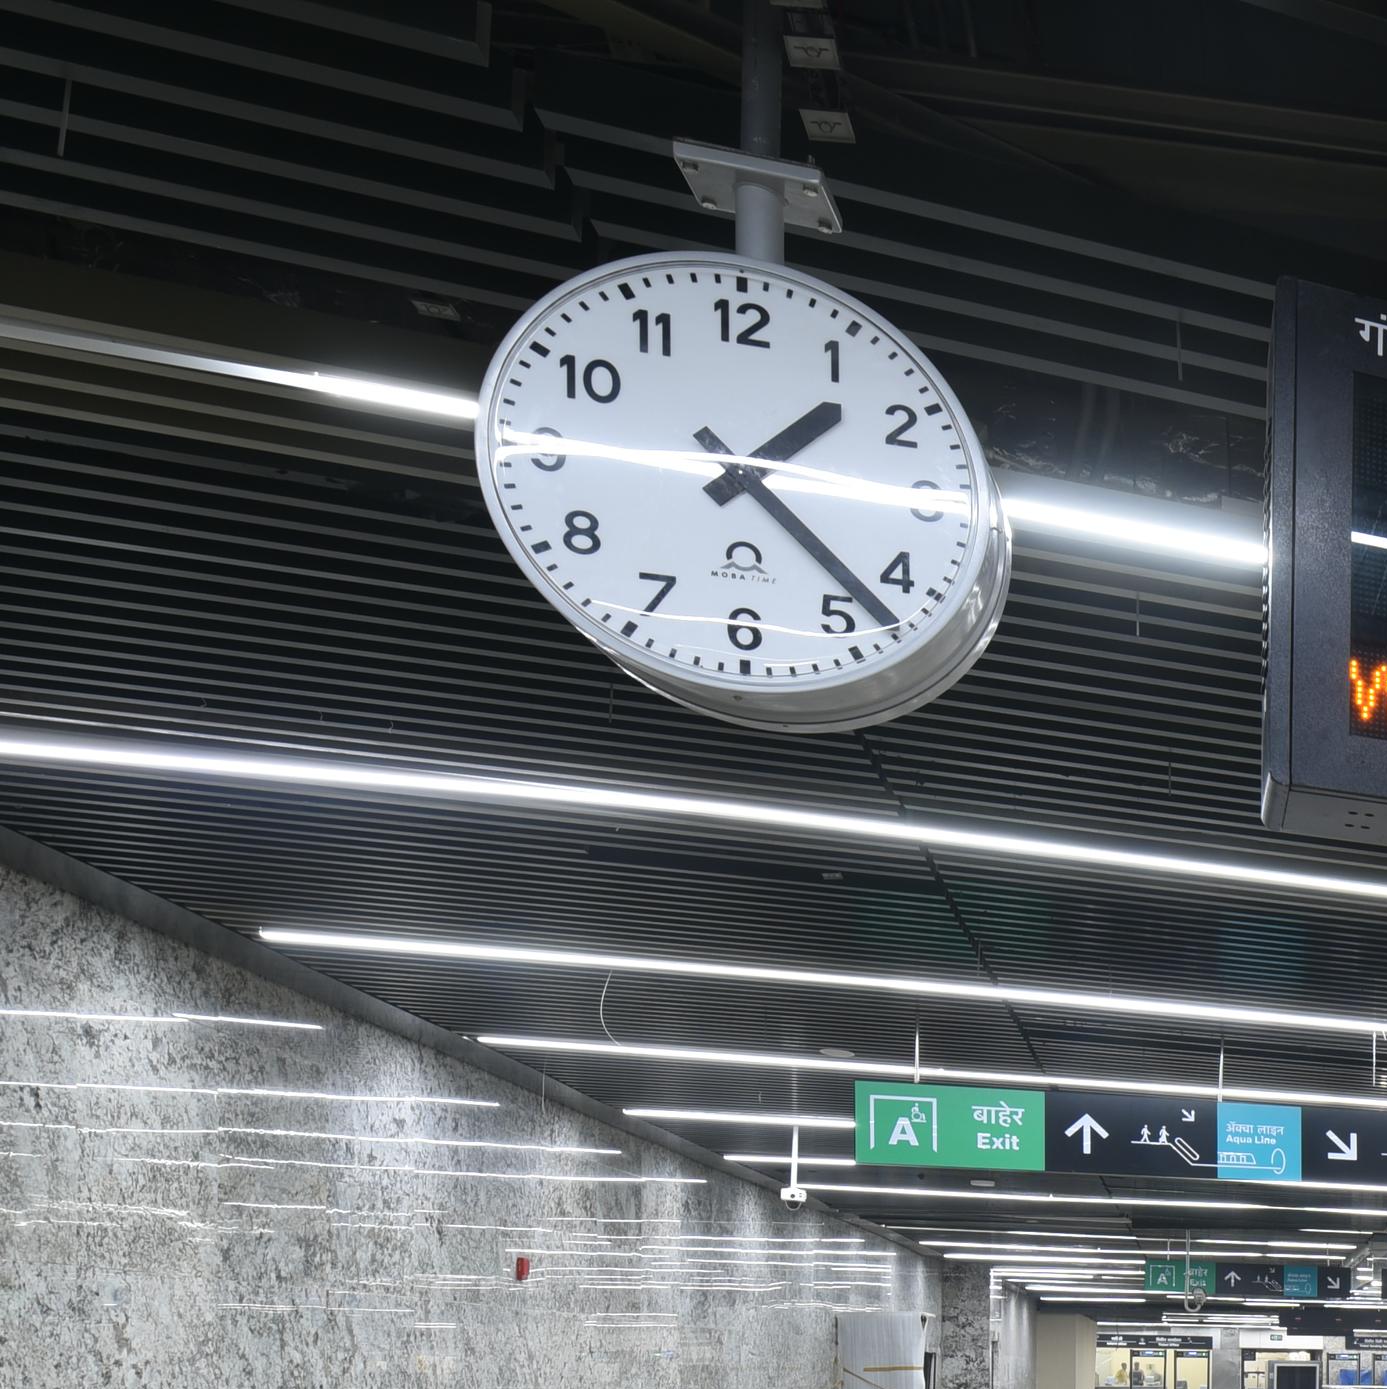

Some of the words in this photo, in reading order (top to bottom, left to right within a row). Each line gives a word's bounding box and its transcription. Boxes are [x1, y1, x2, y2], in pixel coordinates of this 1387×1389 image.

[632, 309, 671, 357] 11
[714, 299, 771, 349] 12
[559, 354, 621, 403] 10
[823, 340, 840, 383] 1
[884, 404, 918, 449] 2
[563, 510, 601, 555] 8
[638, 572, 677, 616] 7
[880, 551, 915, 594] 4
[727, 608, 762, 651] 6
[820, 594, 856, 637] 5
[888, 1117, 919, 1146] A
[971, 1101, 1025, 1128] बाहेर
[1256, 1125, 1285, 1137] लाइन
[976, 1132, 1020, 1151] Exit
[1226, 1134, 1252, 1145] Aqua
[1254, 1135, 1277, 1145] Line
